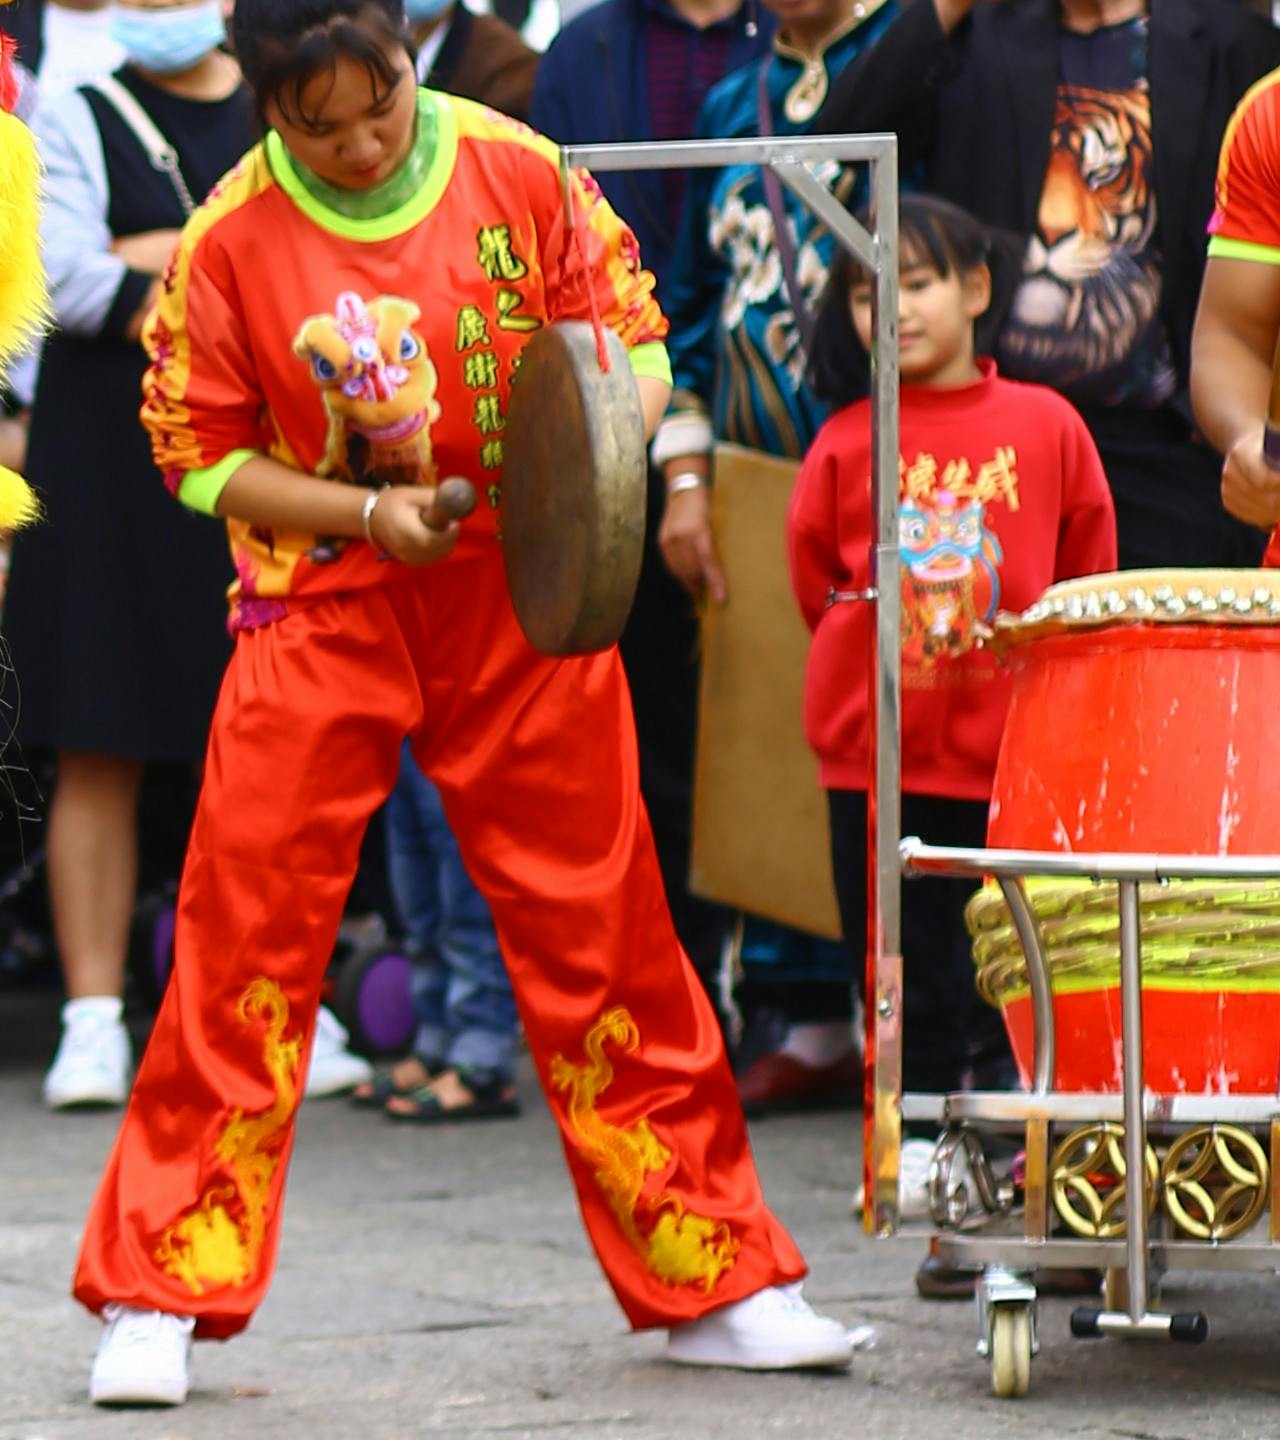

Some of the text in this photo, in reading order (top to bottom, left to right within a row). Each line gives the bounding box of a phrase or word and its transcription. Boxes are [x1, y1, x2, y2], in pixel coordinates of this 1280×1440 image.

[476, 223, 544, 384] 龍之
[868, 446, 1020, 511] 虎生威
